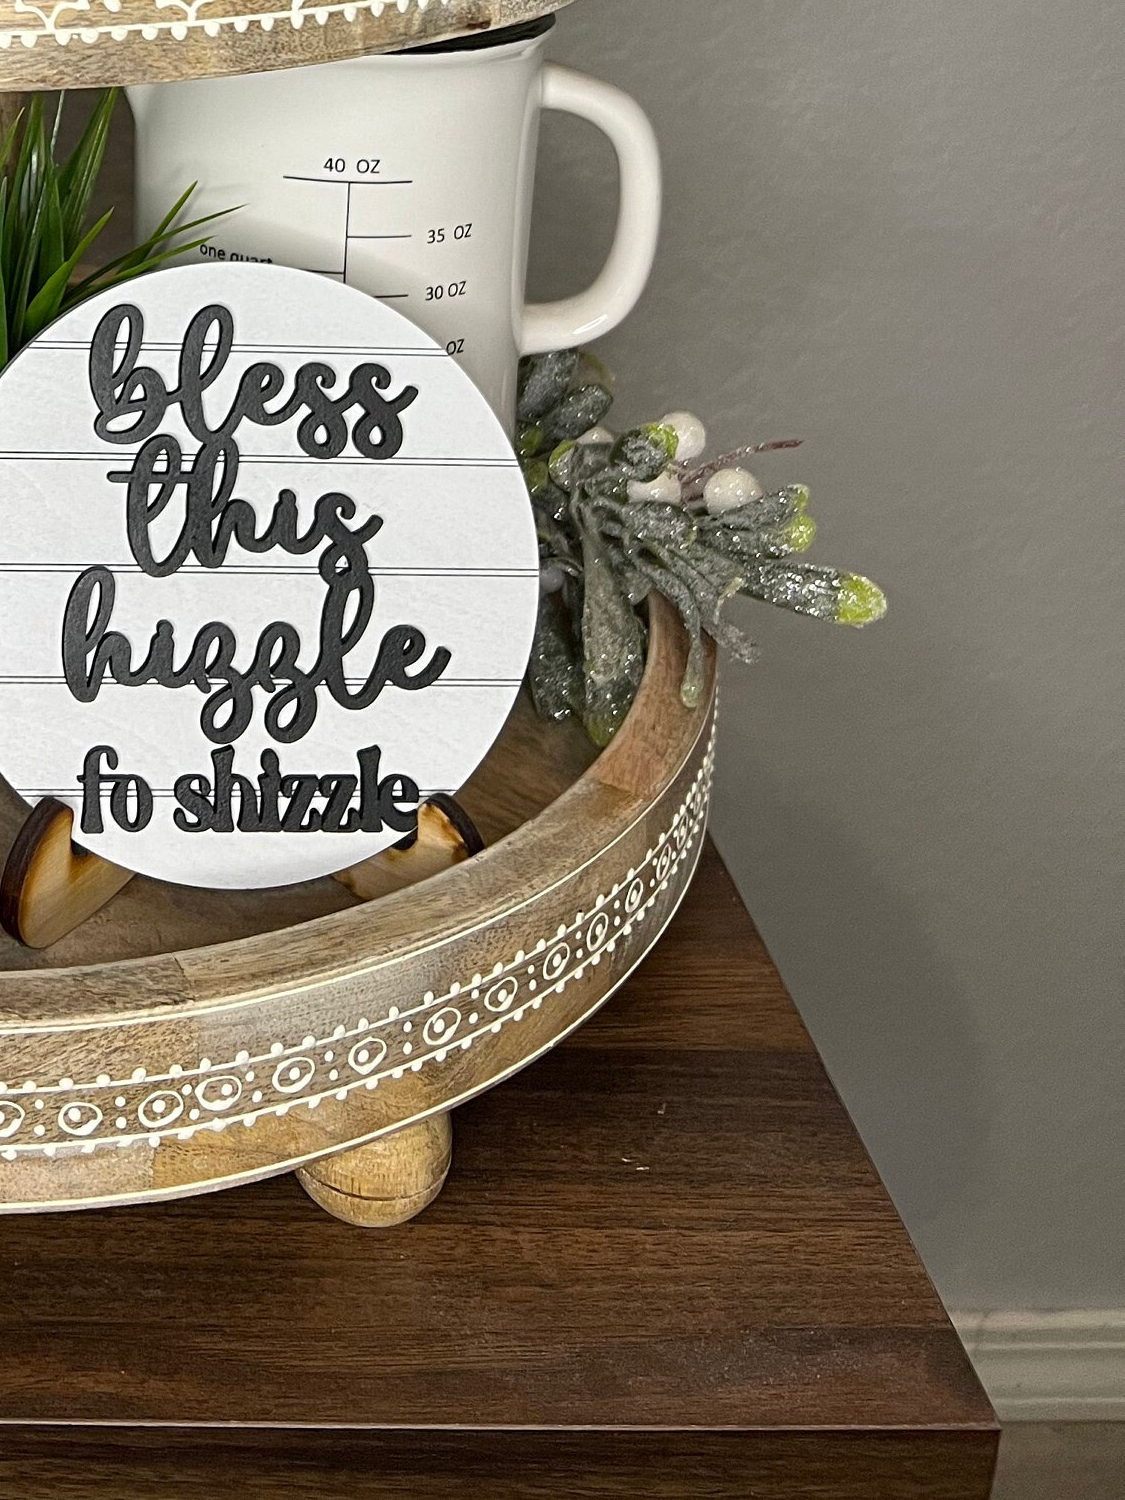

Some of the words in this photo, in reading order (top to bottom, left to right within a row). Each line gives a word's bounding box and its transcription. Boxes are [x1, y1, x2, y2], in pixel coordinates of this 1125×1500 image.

[322, 157, 347, 173] 40
[356, 159, 381, 174] OZ
[426, 227, 446, 244] 35
[453, 222, 473, 240] OZ
[199, 243, 226, 260] one
[424, 285, 444, 301] 30
[447, 280, 467, 298] OZ
[445, 338, 466, 356] OZ
[89, 303, 419, 460] bless
[107, 433, 385, 583] this
[62, 566, 452, 744] hizzle
[76, 745, 154, 835] fo
[173, 745, 421, 834] shizzle
